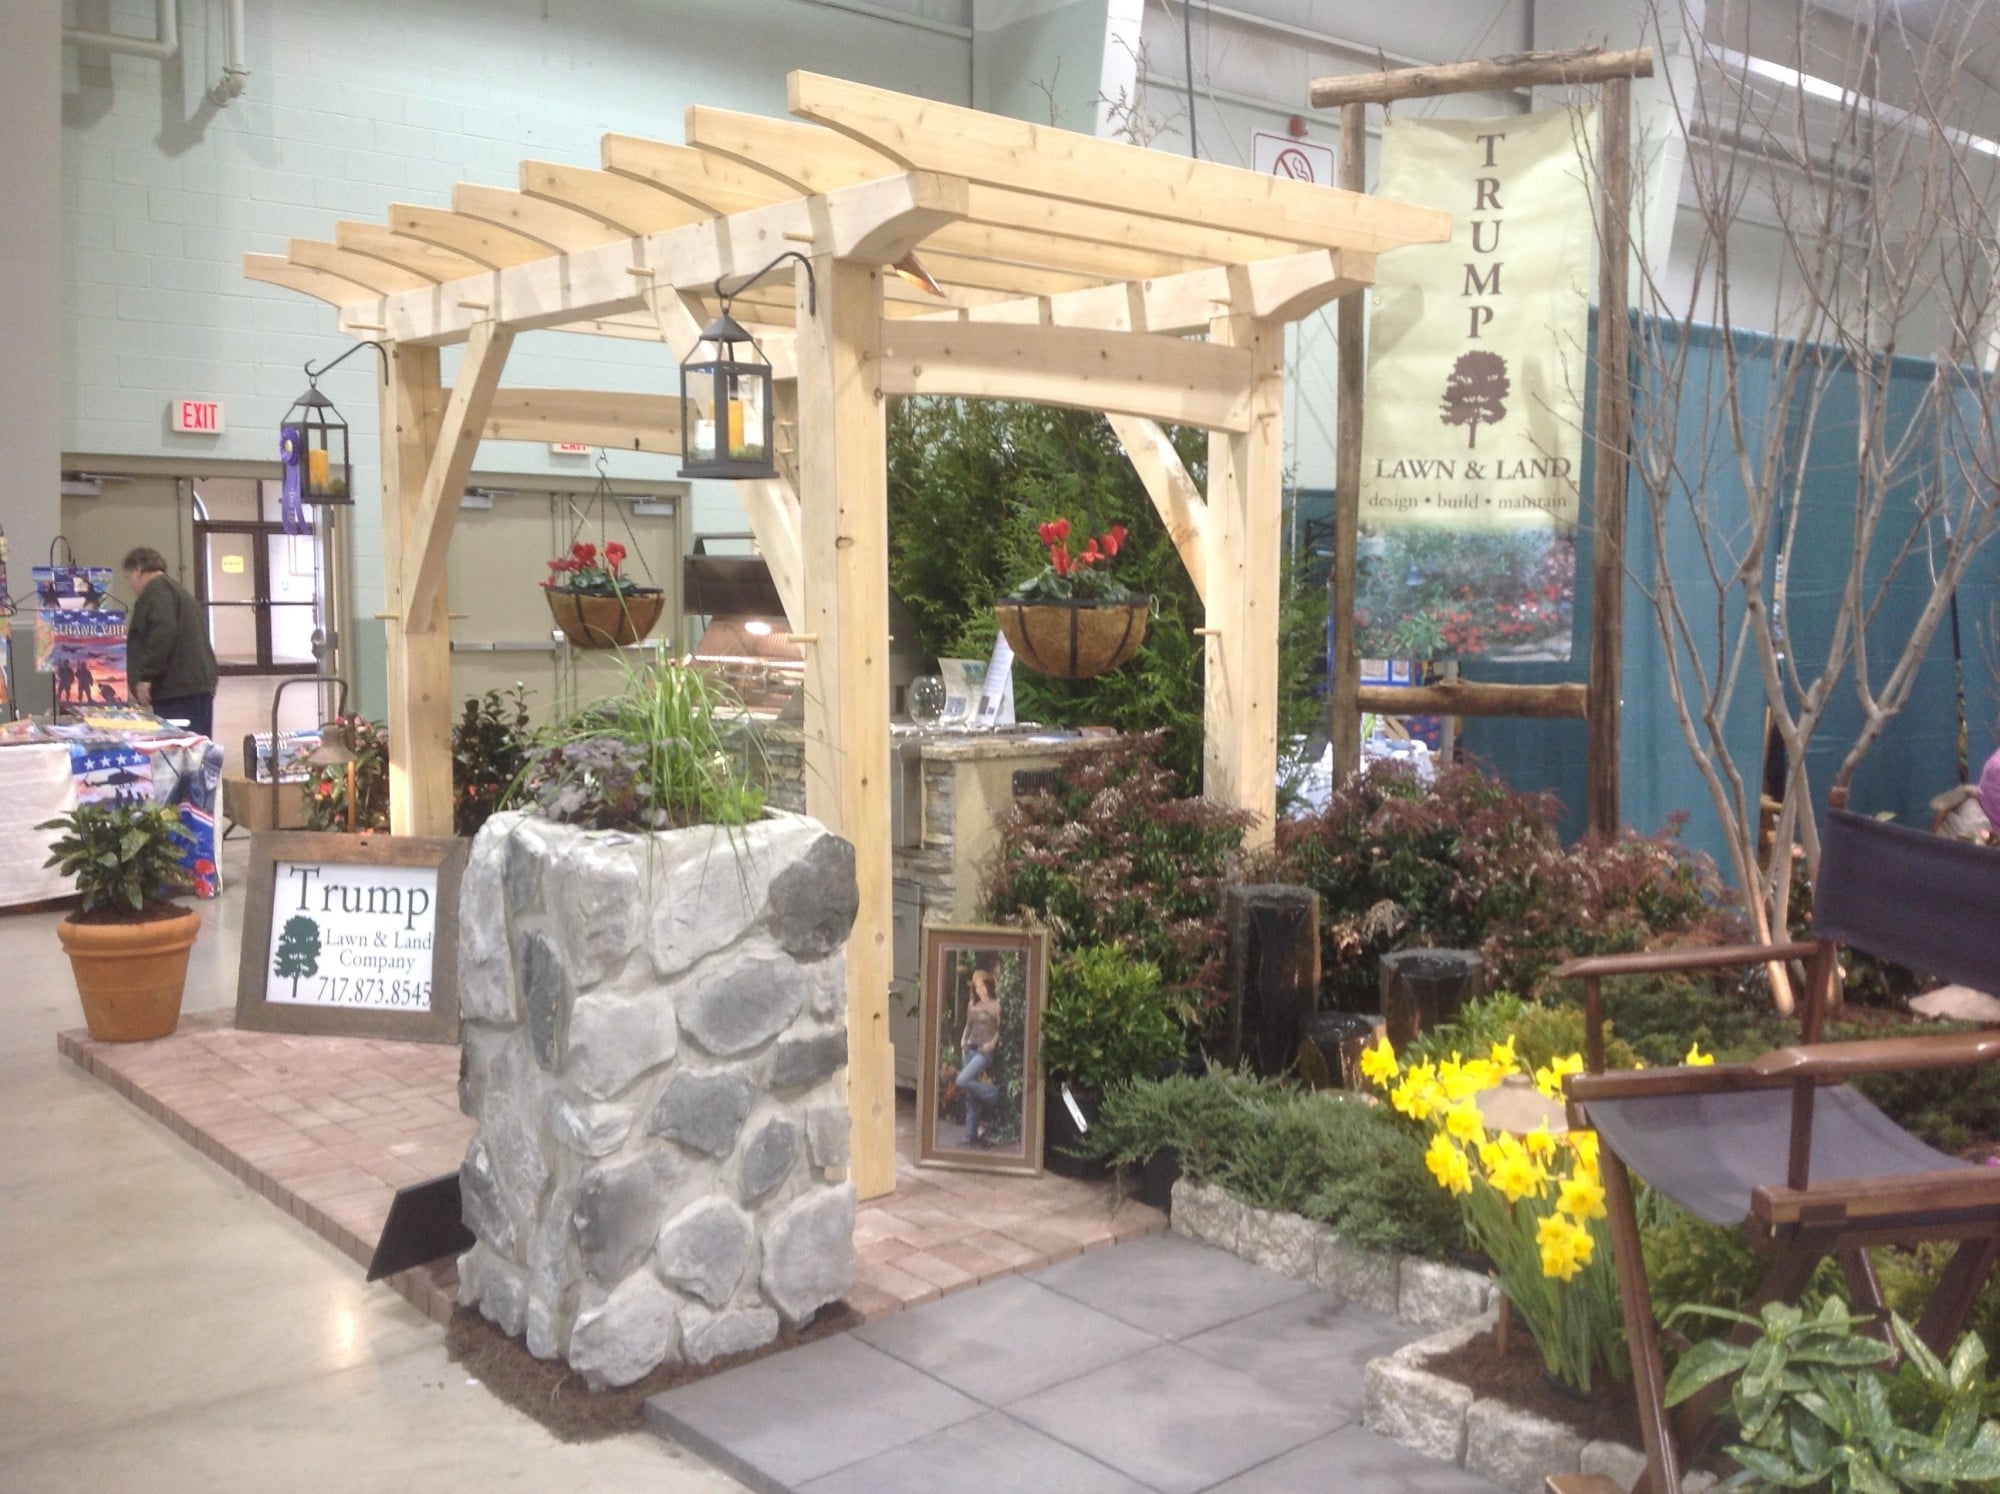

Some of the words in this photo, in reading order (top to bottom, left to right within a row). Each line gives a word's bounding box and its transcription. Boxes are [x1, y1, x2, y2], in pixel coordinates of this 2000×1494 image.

[1461, 133, 1507, 339] TRUMP
[182, 402, 218, 429] EXIT
[1376, 457, 1457, 480] LAWN
[1464, 459, 1486, 480] &
[1496, 456, 1571, 480] LAND
[1369, 491, 1418, 512] design
[1437, 493, 1479, 509] build
[289, 865, 430, 931] Trump
[326, 928, 368, 948] Lawn
[373, 930, 389, 948] &
[394, 931, 433, 951] Land
[339, 949, 417, 975] Company
[317, 975, 432, 1007] 717.873.8545
